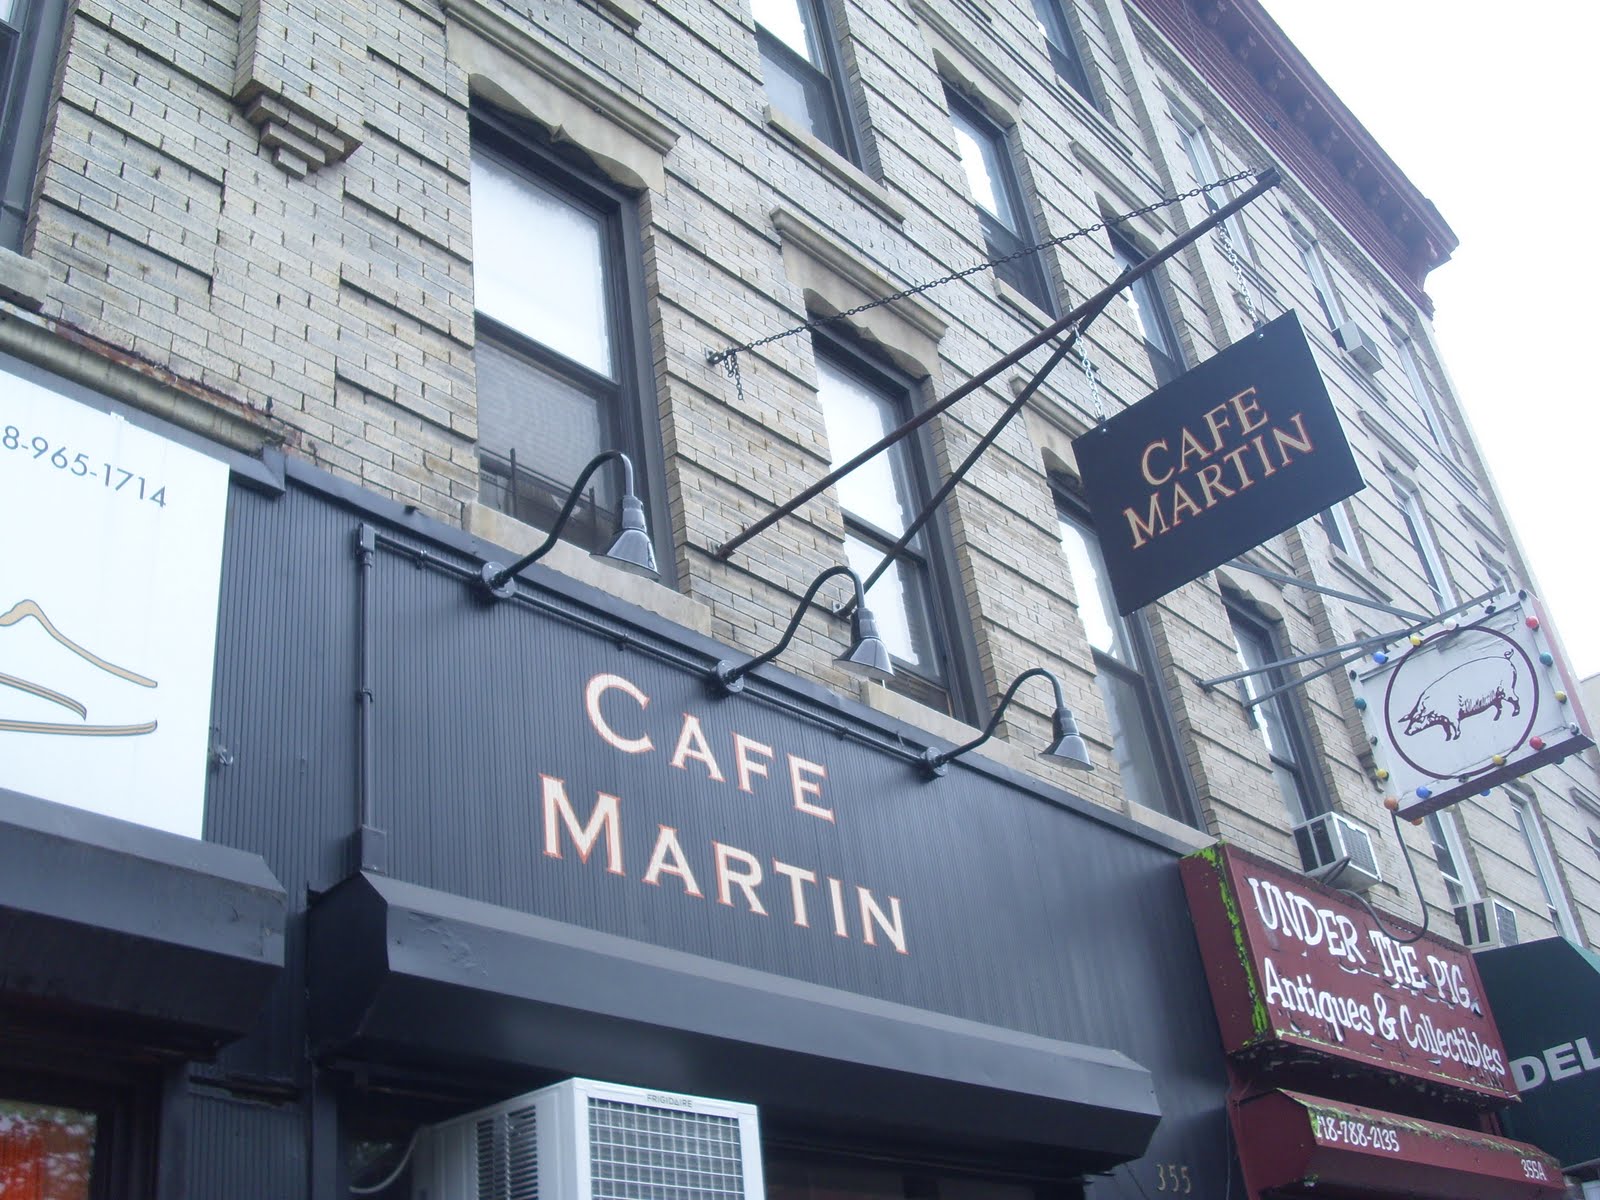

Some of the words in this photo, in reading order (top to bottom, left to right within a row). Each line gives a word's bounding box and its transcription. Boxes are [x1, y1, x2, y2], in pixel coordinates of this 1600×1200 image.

[2, 425, 166, 508] 8-965-1714
[1123, 413, 1314, 550] MARTIN
[1141, 386, 1268, 486] CAFE
[585, 673, 835, 824] CAFE
[538, 773, 909, 955] MARTIN
[1248, 878, 1366, 964] UNDER
[1369, 930, 1426, 989] THE
[1264, 957, 1375, 1042] Antiques
[1374, 993, 1399, 1041] &
[1400, 1004, 1506, 1076] Collectibles
[1509, 1037, 1600, 1092] DEL
[646, 1094, 693, 1108] FRIGIDAIRE
[1155, 1163, 1191, 1194] 355
[1521, 1158, 1547, 1181] 355A
